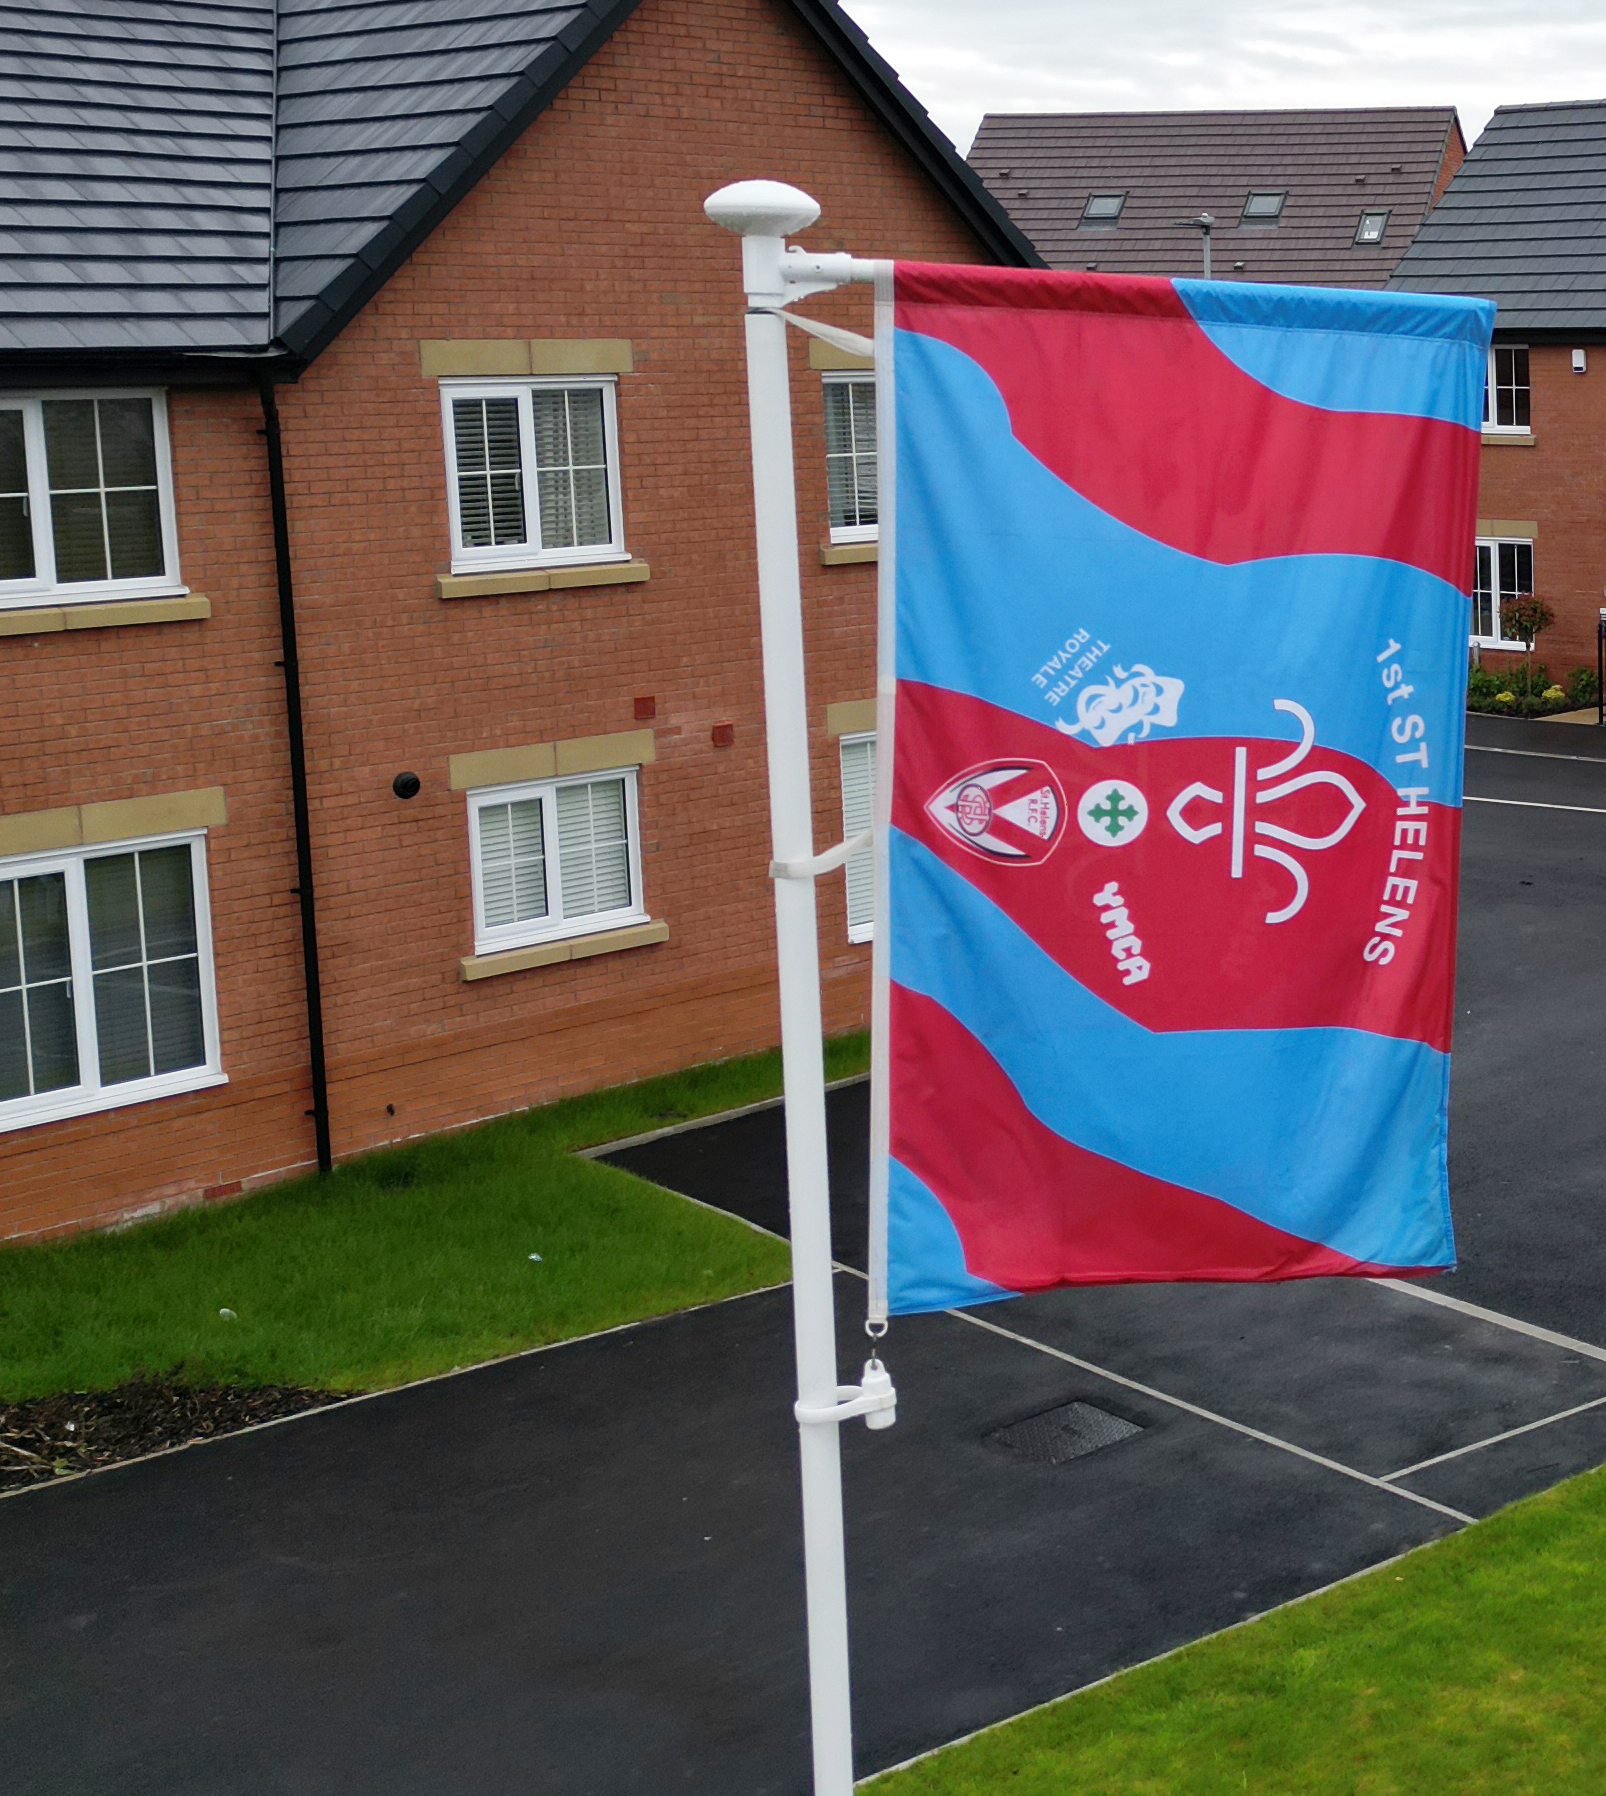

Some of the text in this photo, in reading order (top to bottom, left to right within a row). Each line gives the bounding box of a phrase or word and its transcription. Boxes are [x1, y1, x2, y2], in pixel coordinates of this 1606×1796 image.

[1031, 627, 1091, 689] ROYALE
[1044, 640, 1111, 707] THEATRE
[1363, 638, 1430, 966] 1st ST HELENS
[1093, 881, 1151, 986] YMCA
